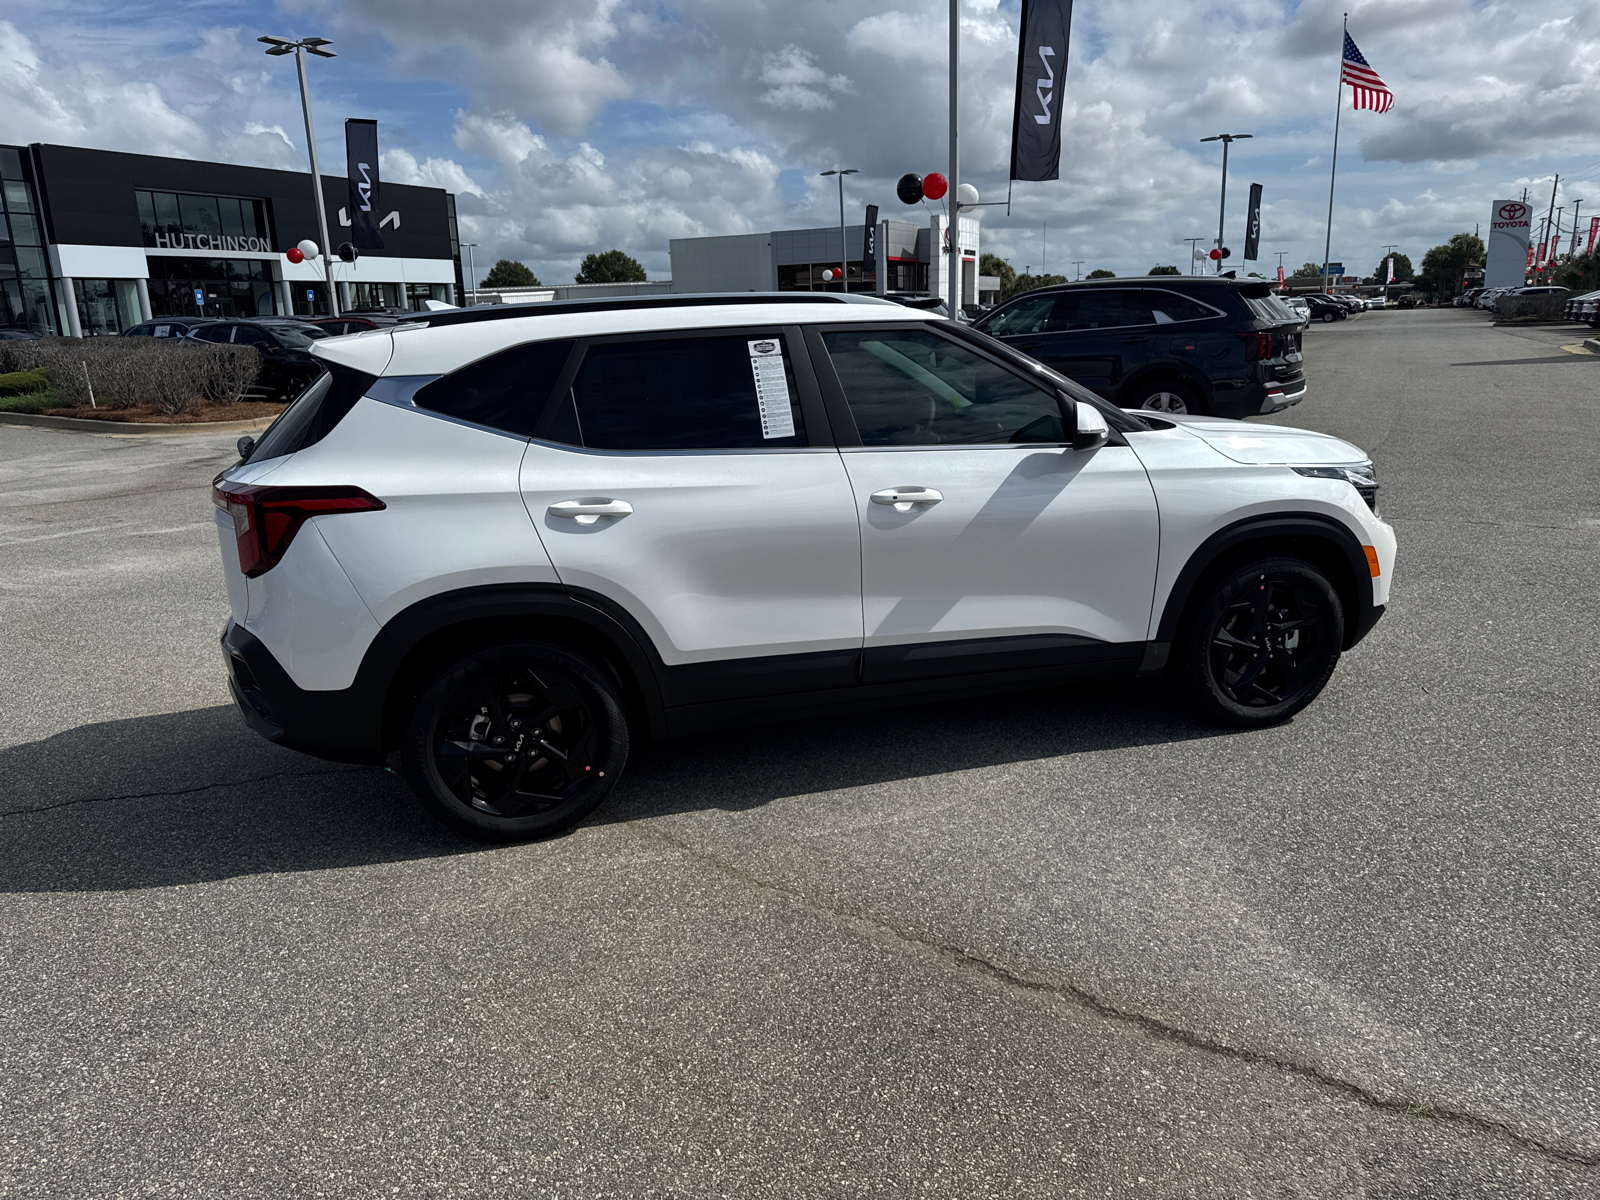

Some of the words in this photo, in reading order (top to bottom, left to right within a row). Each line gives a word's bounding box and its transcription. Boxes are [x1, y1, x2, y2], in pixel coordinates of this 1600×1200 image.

[1034, 46, 1055, 124] KIA
[357, 163, 372, 211] KIA
[1250, 208, 1260, 239] KIA
[1493, 221, 1529, 229] TOYOTA
[155, 232, 271, 253] HUTCHINSON
